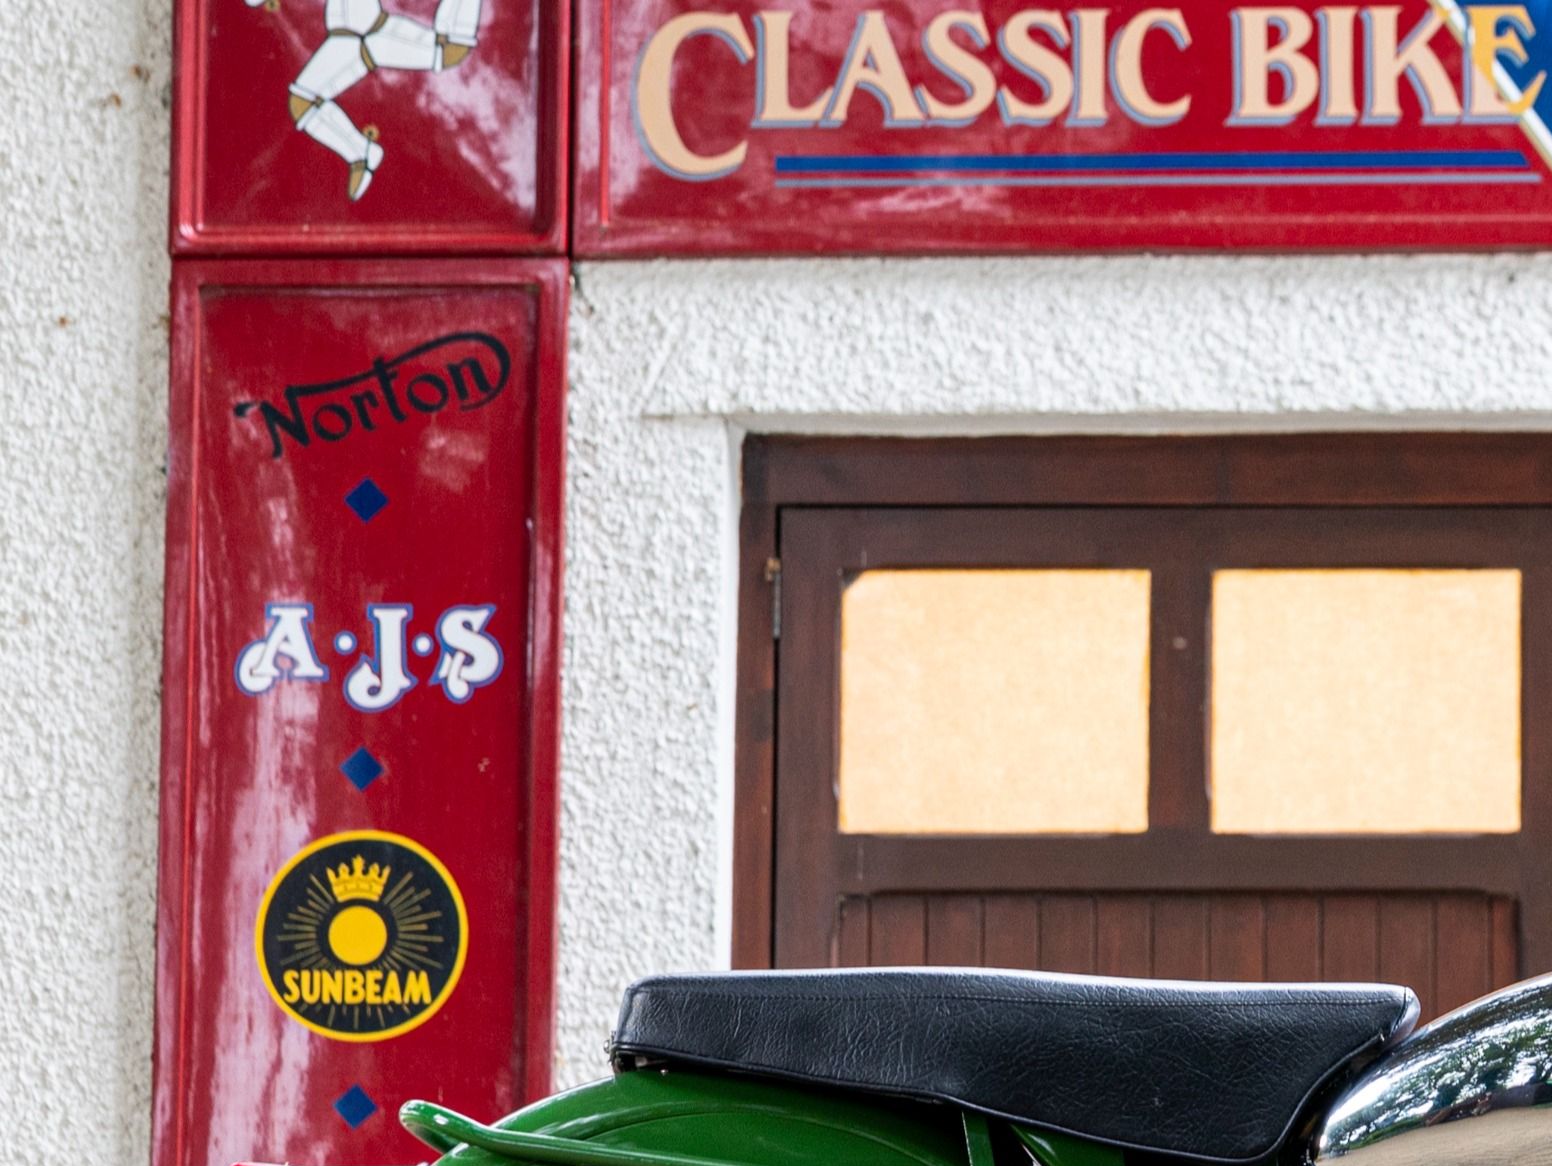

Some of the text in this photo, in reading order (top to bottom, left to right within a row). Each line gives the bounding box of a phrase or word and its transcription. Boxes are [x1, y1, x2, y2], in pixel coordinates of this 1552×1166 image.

[632, 8, 1193, 182] CLASSIC
[1224, 4, 1548, 126] BIKE
[233, 331, 511, 459] Norton
[282, 968, 432, 1005] SUNBEAM
